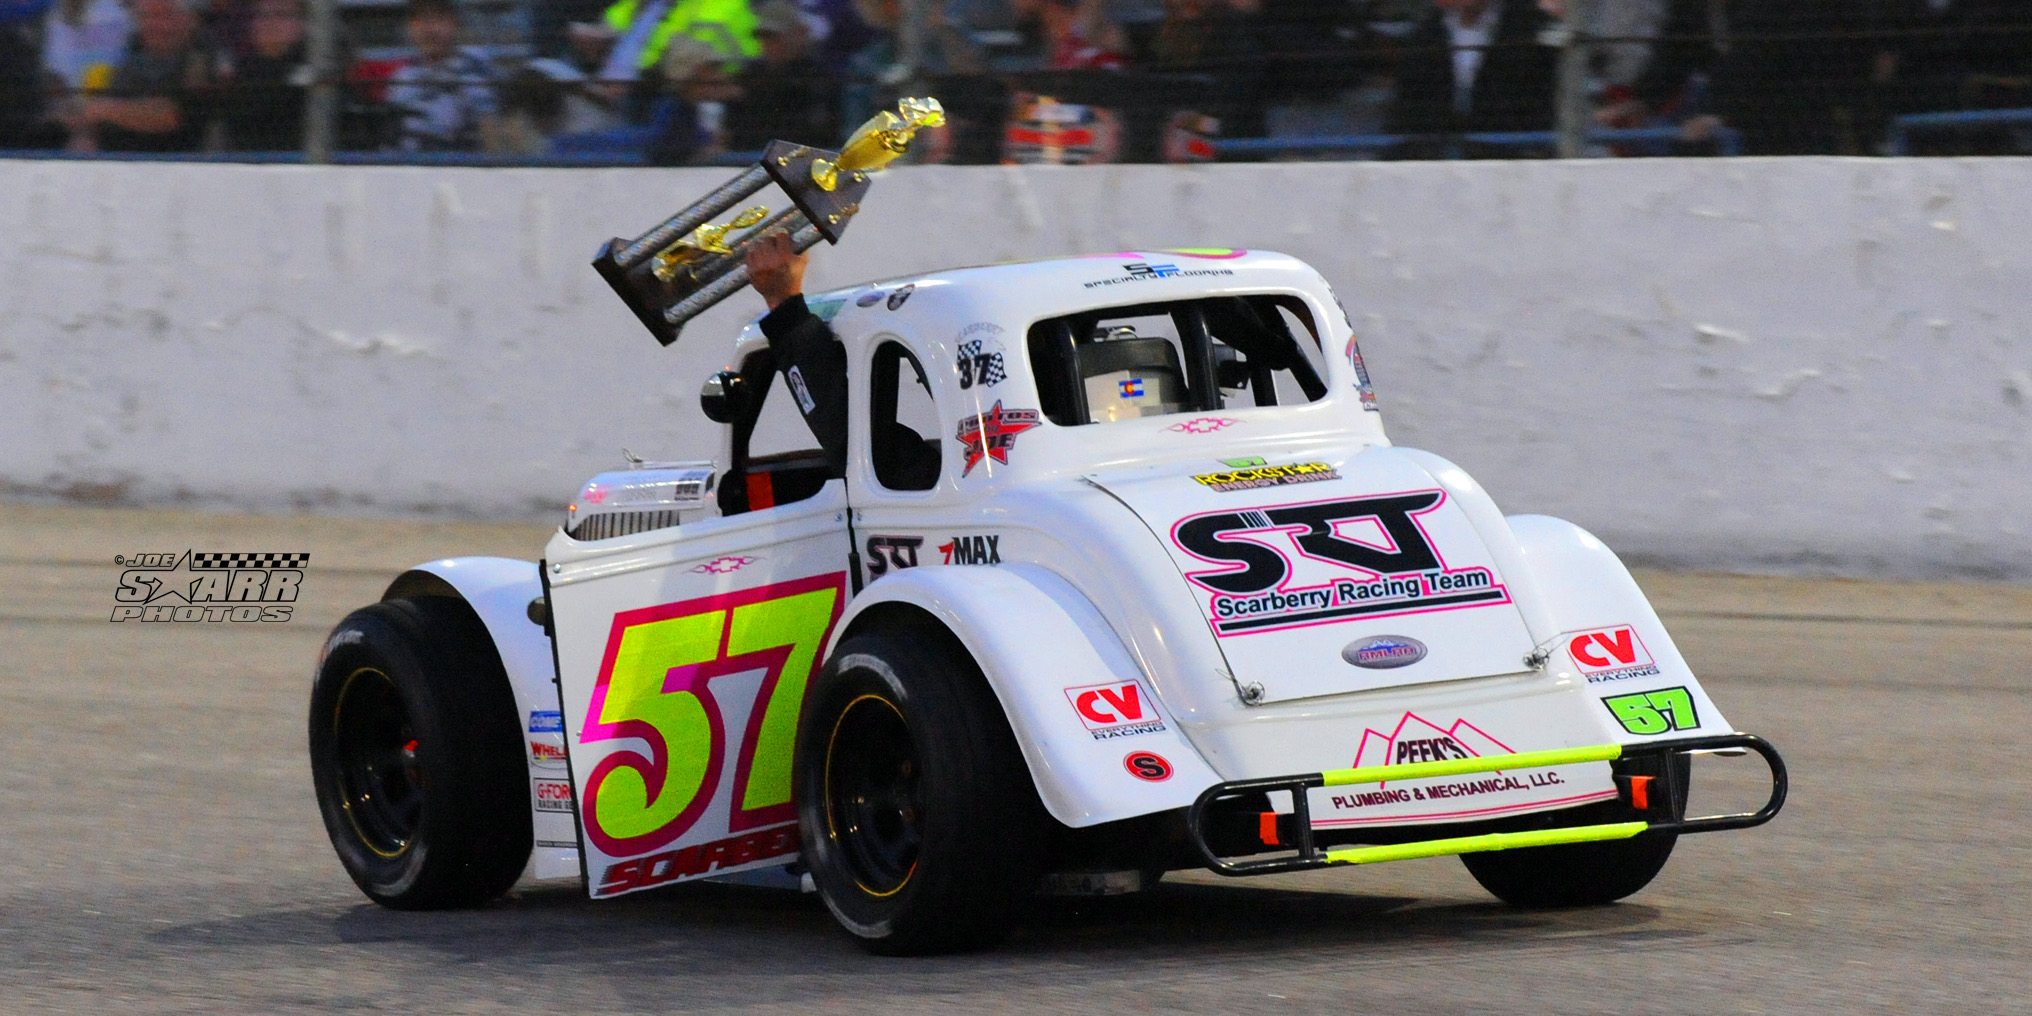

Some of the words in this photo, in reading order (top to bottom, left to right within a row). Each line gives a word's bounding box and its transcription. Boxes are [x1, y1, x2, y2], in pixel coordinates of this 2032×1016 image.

[1084, 273, 1158, 289] SPECIALTY
[1166, 269, 1234, 278] FLOORING
[957, 353, 992, 390] 37
[1212, 477, 1279, 492] ENERGY
[1285, 470, 1340, 485] DRINK
[1217, 588, 1332, 618] Scarberry
[1338, 577, 1420, 602] Racing
[1424, 570, 1489, 592] Team
[1569, 628, 1637, 667] CV
[1584, 665, 1657, 678] EVERYTHING
[1587, 668, 1661, 683] RACING
[580, 571, 847, 857] 57
[1076, 684, 1143, 724] CV
[1599, 685, 1702, 736] 57
[1090, 721, 1164, 736] EVERYTHING
[1093, 725, 1167, 740] RACING
[1395, 736, 1469, 765] PEEK'S
[1133, 756, 1165, 778] S
[537, 783, 572, 800] G-FOR
[1330, 788, 1412, 810] PLUMBING
[1412, 787, 1426, 801] &
[1425, 776, 1530, 801] MECHANICAL,
[1528, 770, 1566, 788] LLC.
